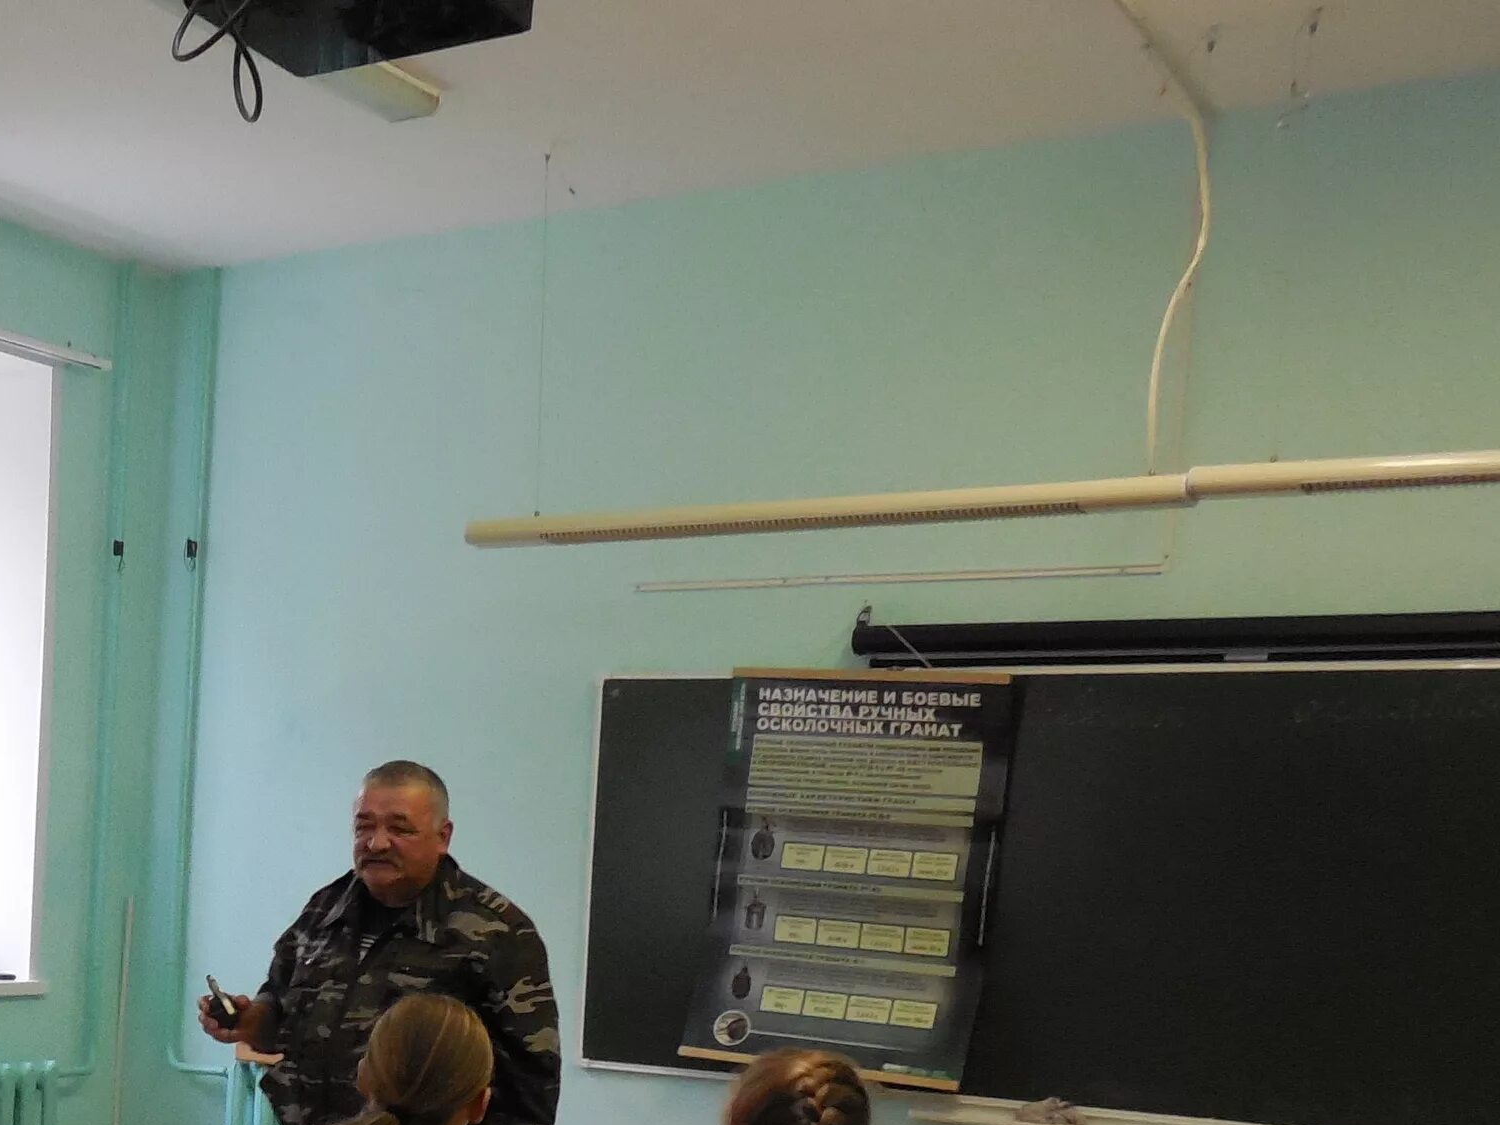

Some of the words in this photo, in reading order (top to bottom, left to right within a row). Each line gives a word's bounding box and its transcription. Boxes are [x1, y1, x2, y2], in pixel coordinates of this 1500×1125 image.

[758, 687, 878, 704] НАЗНАЧЕНИЕ
[883, 690, 897, 704] И
[902, 691, 981, 707] БОЕВЫЕ
[758, 702, 853, 719] СВОЙСТВА
[858, 706, 937, 721] РУЧНЫХ
[756, 717, 884, 735] ОСКОЛОЧНЫХ
[889, 722, 963, 738] ГРАНАТ
